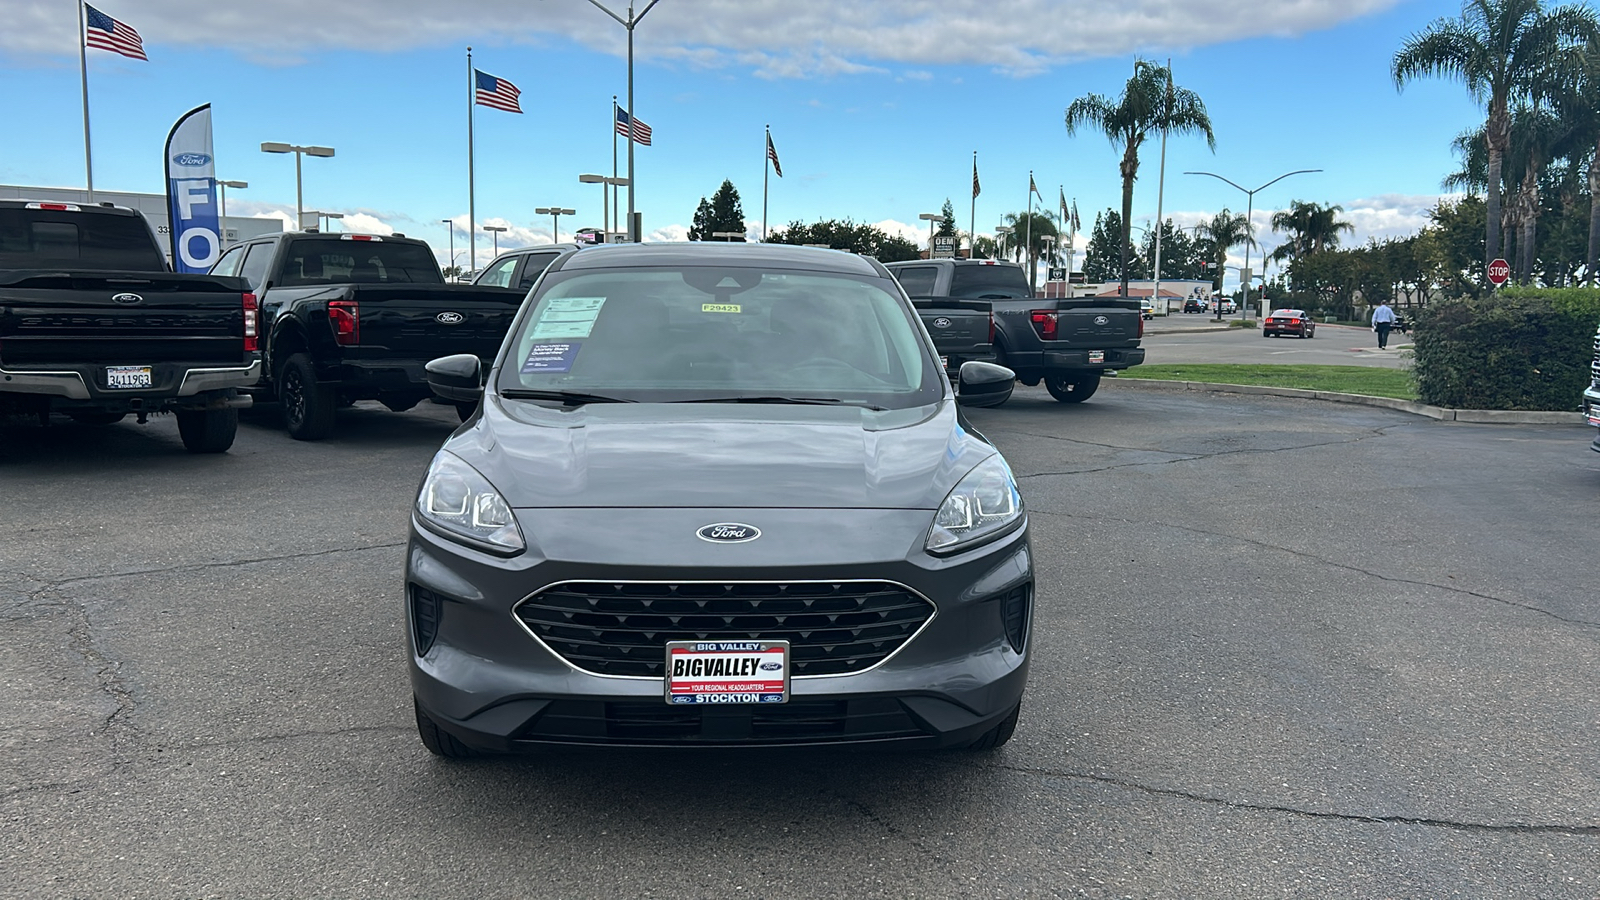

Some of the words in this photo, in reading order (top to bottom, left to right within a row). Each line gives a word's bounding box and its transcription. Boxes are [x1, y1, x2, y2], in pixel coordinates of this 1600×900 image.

[180, 155, 205, 165] Ford
[1489, 266, 1508, 276] STOP
[110, 374, 150, 385] 34119G3
[711, 525, 746, 538] Ford
[697, 643, 718, 651] BIG
[720, 643, 760, 651] VALLEY
[673, 657, 761, 677] BIGVALLEY
[763, 662, 779, 670] Ford
[696, 694, 760, 703] STOCKTON
